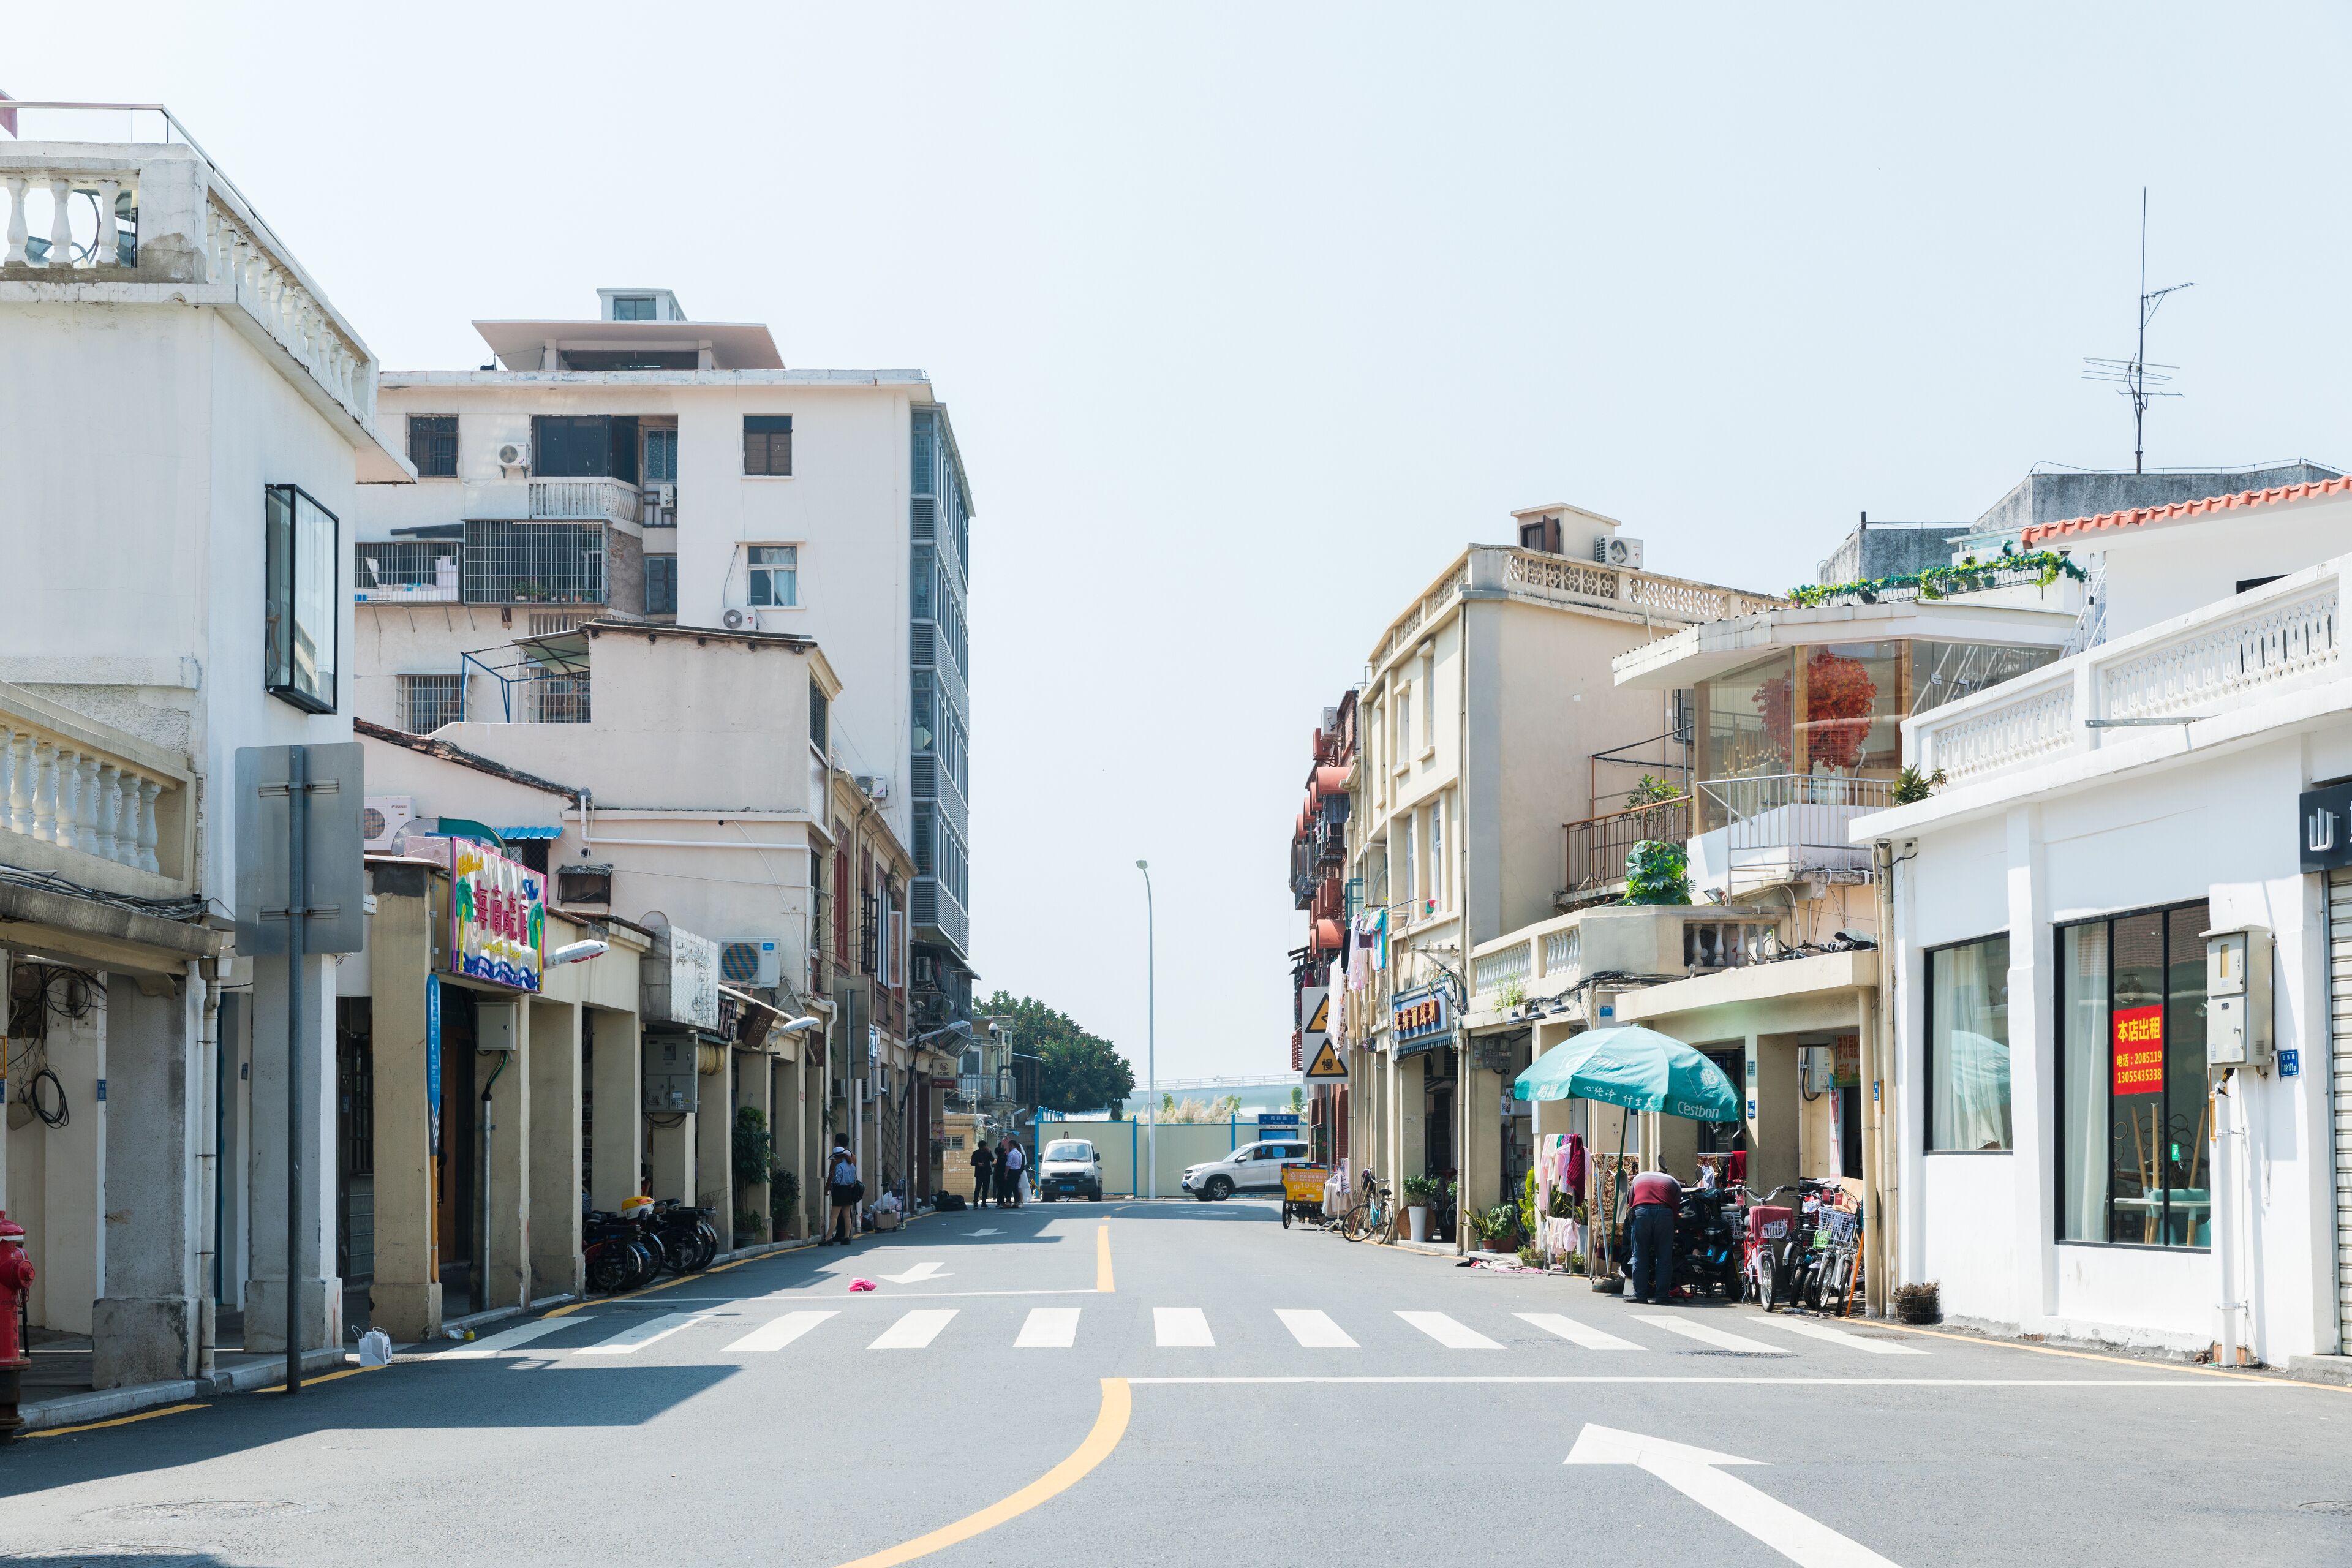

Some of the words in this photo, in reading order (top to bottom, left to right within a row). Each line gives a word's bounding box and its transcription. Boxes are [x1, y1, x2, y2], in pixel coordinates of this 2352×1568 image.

[2117, 1017, 2160, 1043] 本店出租
[1322, 1058, 1333, 1071] 慢
[2117, 1068, 2162, 1084] 13055435338
[1678, 1101, 1720, 1118] C'estbon
